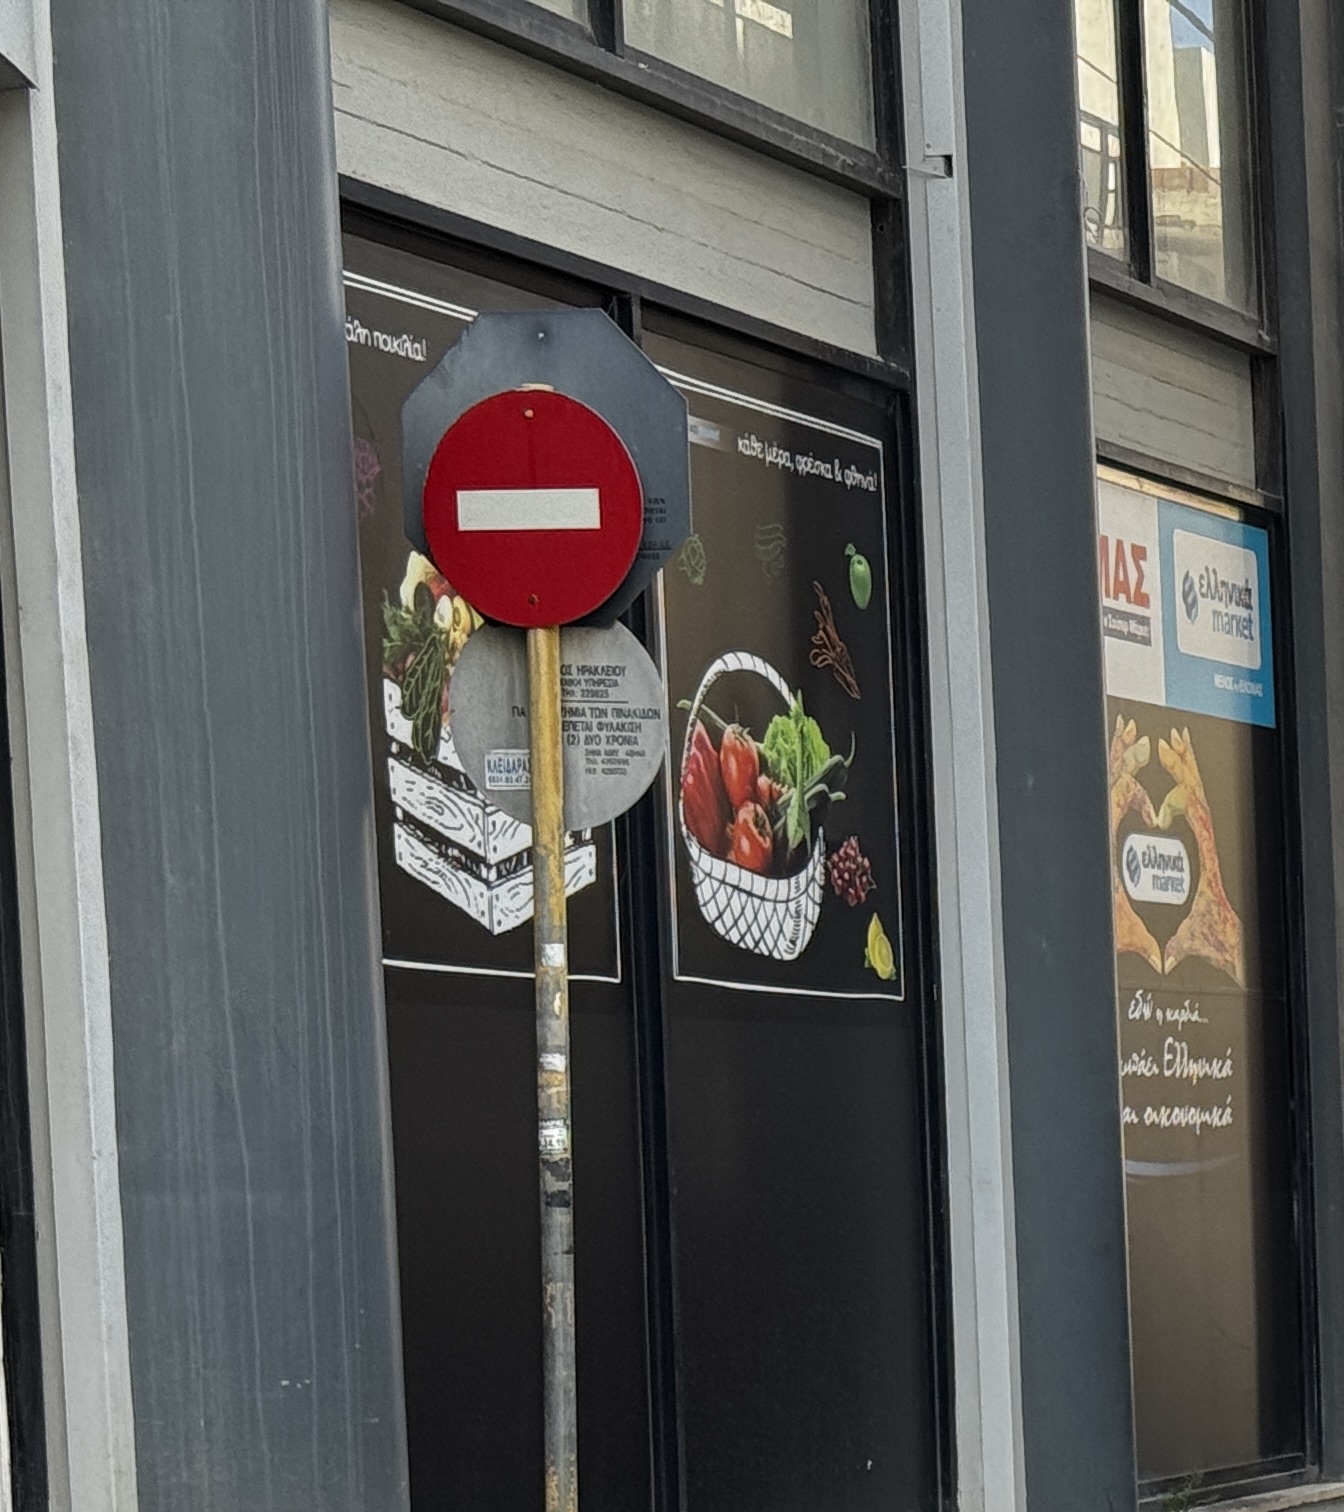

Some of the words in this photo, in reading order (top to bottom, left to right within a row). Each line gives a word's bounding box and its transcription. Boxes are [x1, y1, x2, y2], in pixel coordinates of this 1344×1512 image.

[373, 332, 427, 361] ποικιλία!
[737, 432, 764, 460] κάθε
[765, 440, 794, 472] μέρα,
[795, 451, 833, 479] φρέσκα
[834, 458, 843, 483] &
[844, 465, 877, 492] φθηνά!
[1199, 565, 1254, 612] ελληνικά
[1212, 608, 1254, 642] market
[577, 664, 627, 677] ΗΡΑΚΛΕΙΟΥ
[589, 706, 608, 719] ΤΩΝ
[611, 707, 662, 721] ΠΙΝΑΚΙΔΩΝ
[566, 735, 581, 747] (2)
[583, 734, 602, 746] ΔΥΟ
[605, 735, 639, 747] ΧΡΟΝΙΑ
[1141, 844, 1185, 874] ελληνικά
[1151, 874, 1185, 893] market
[1128, 990, 1153, 1020] εδώ
[1155, 1008, 1163, 1026] η
[1163, 1036, 1233, 1086] Ελληνικά
[1144, 1095, 1233, 1136] οικονομικά
